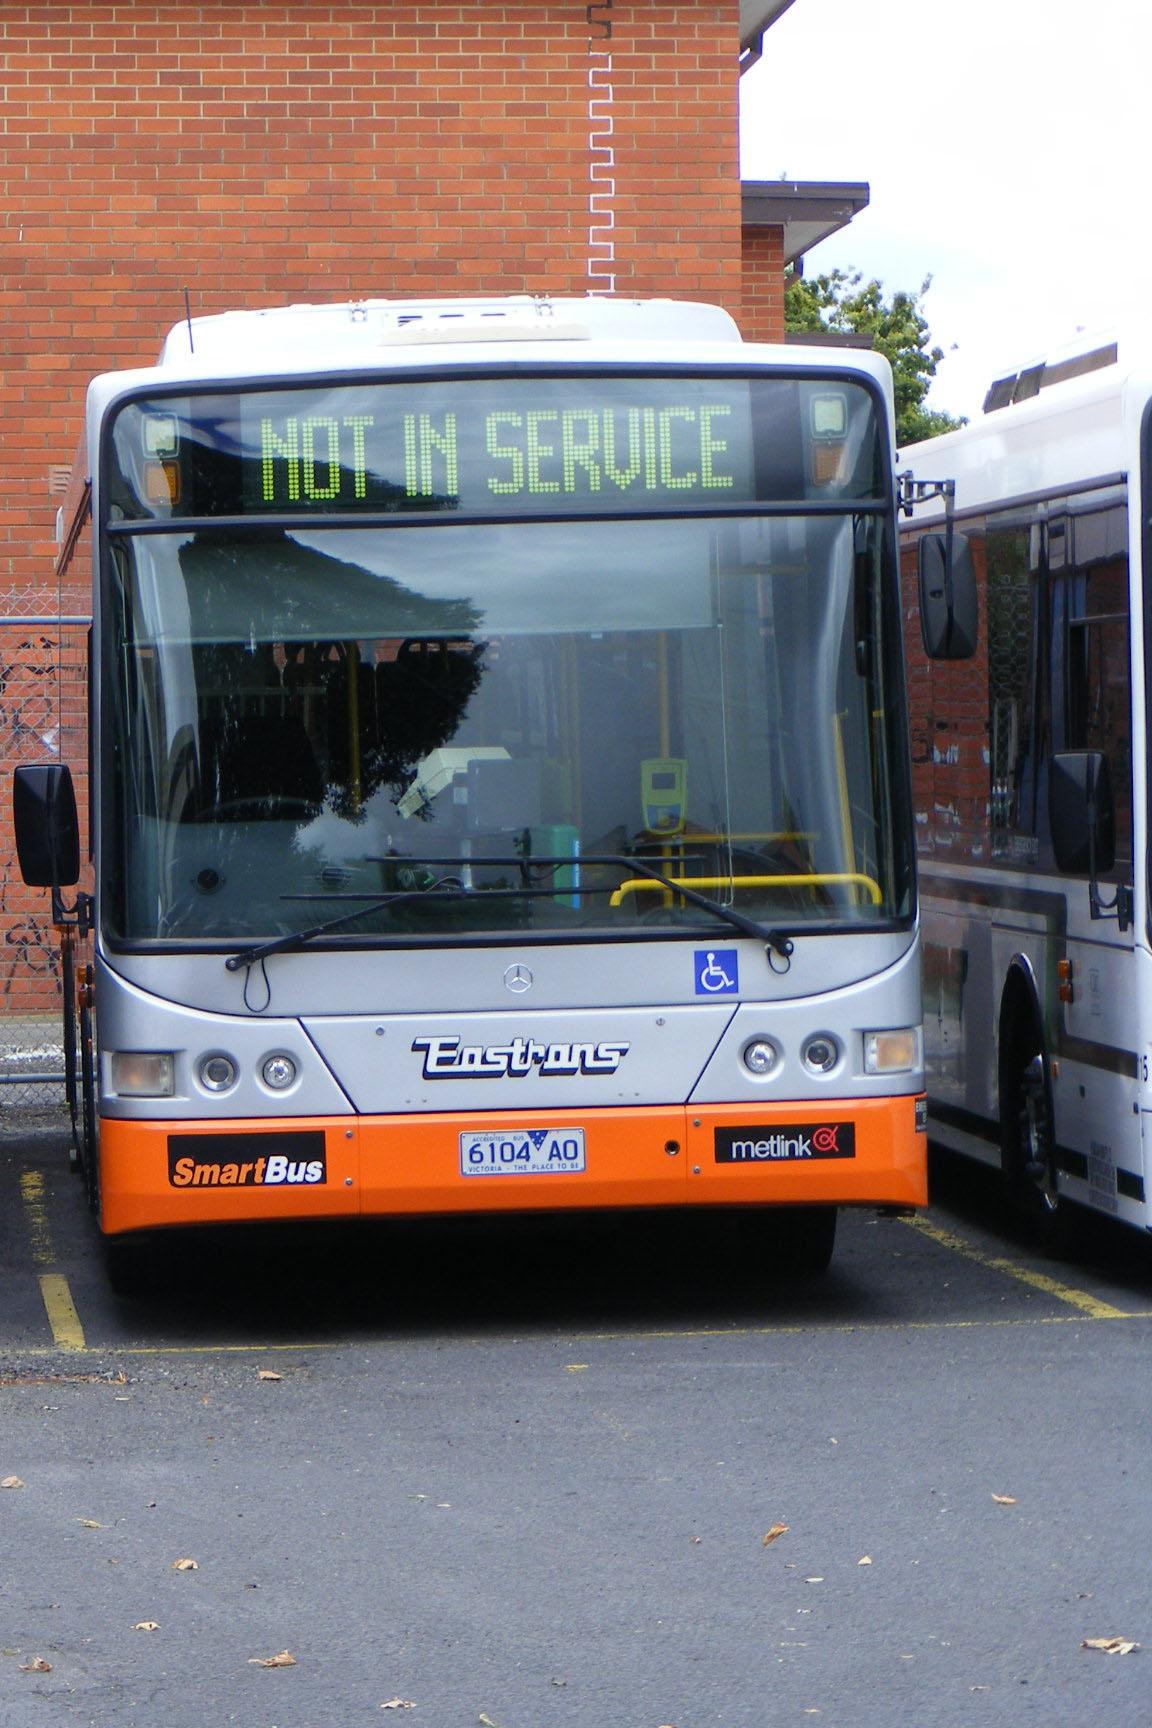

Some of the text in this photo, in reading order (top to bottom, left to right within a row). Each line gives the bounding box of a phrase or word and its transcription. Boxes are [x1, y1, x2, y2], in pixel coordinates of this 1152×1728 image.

[261, 405, 734, 500] NOT IN SERVICE
[411, 1035, 631, 1081] Eastrans
[468, 1141, 531, 1164] 6104
[731, 1134, 812, 1158] metlink
[173, 1155, 324, 1186] SmartBus
[468, 1165, 502, 1173] VICTORIA
